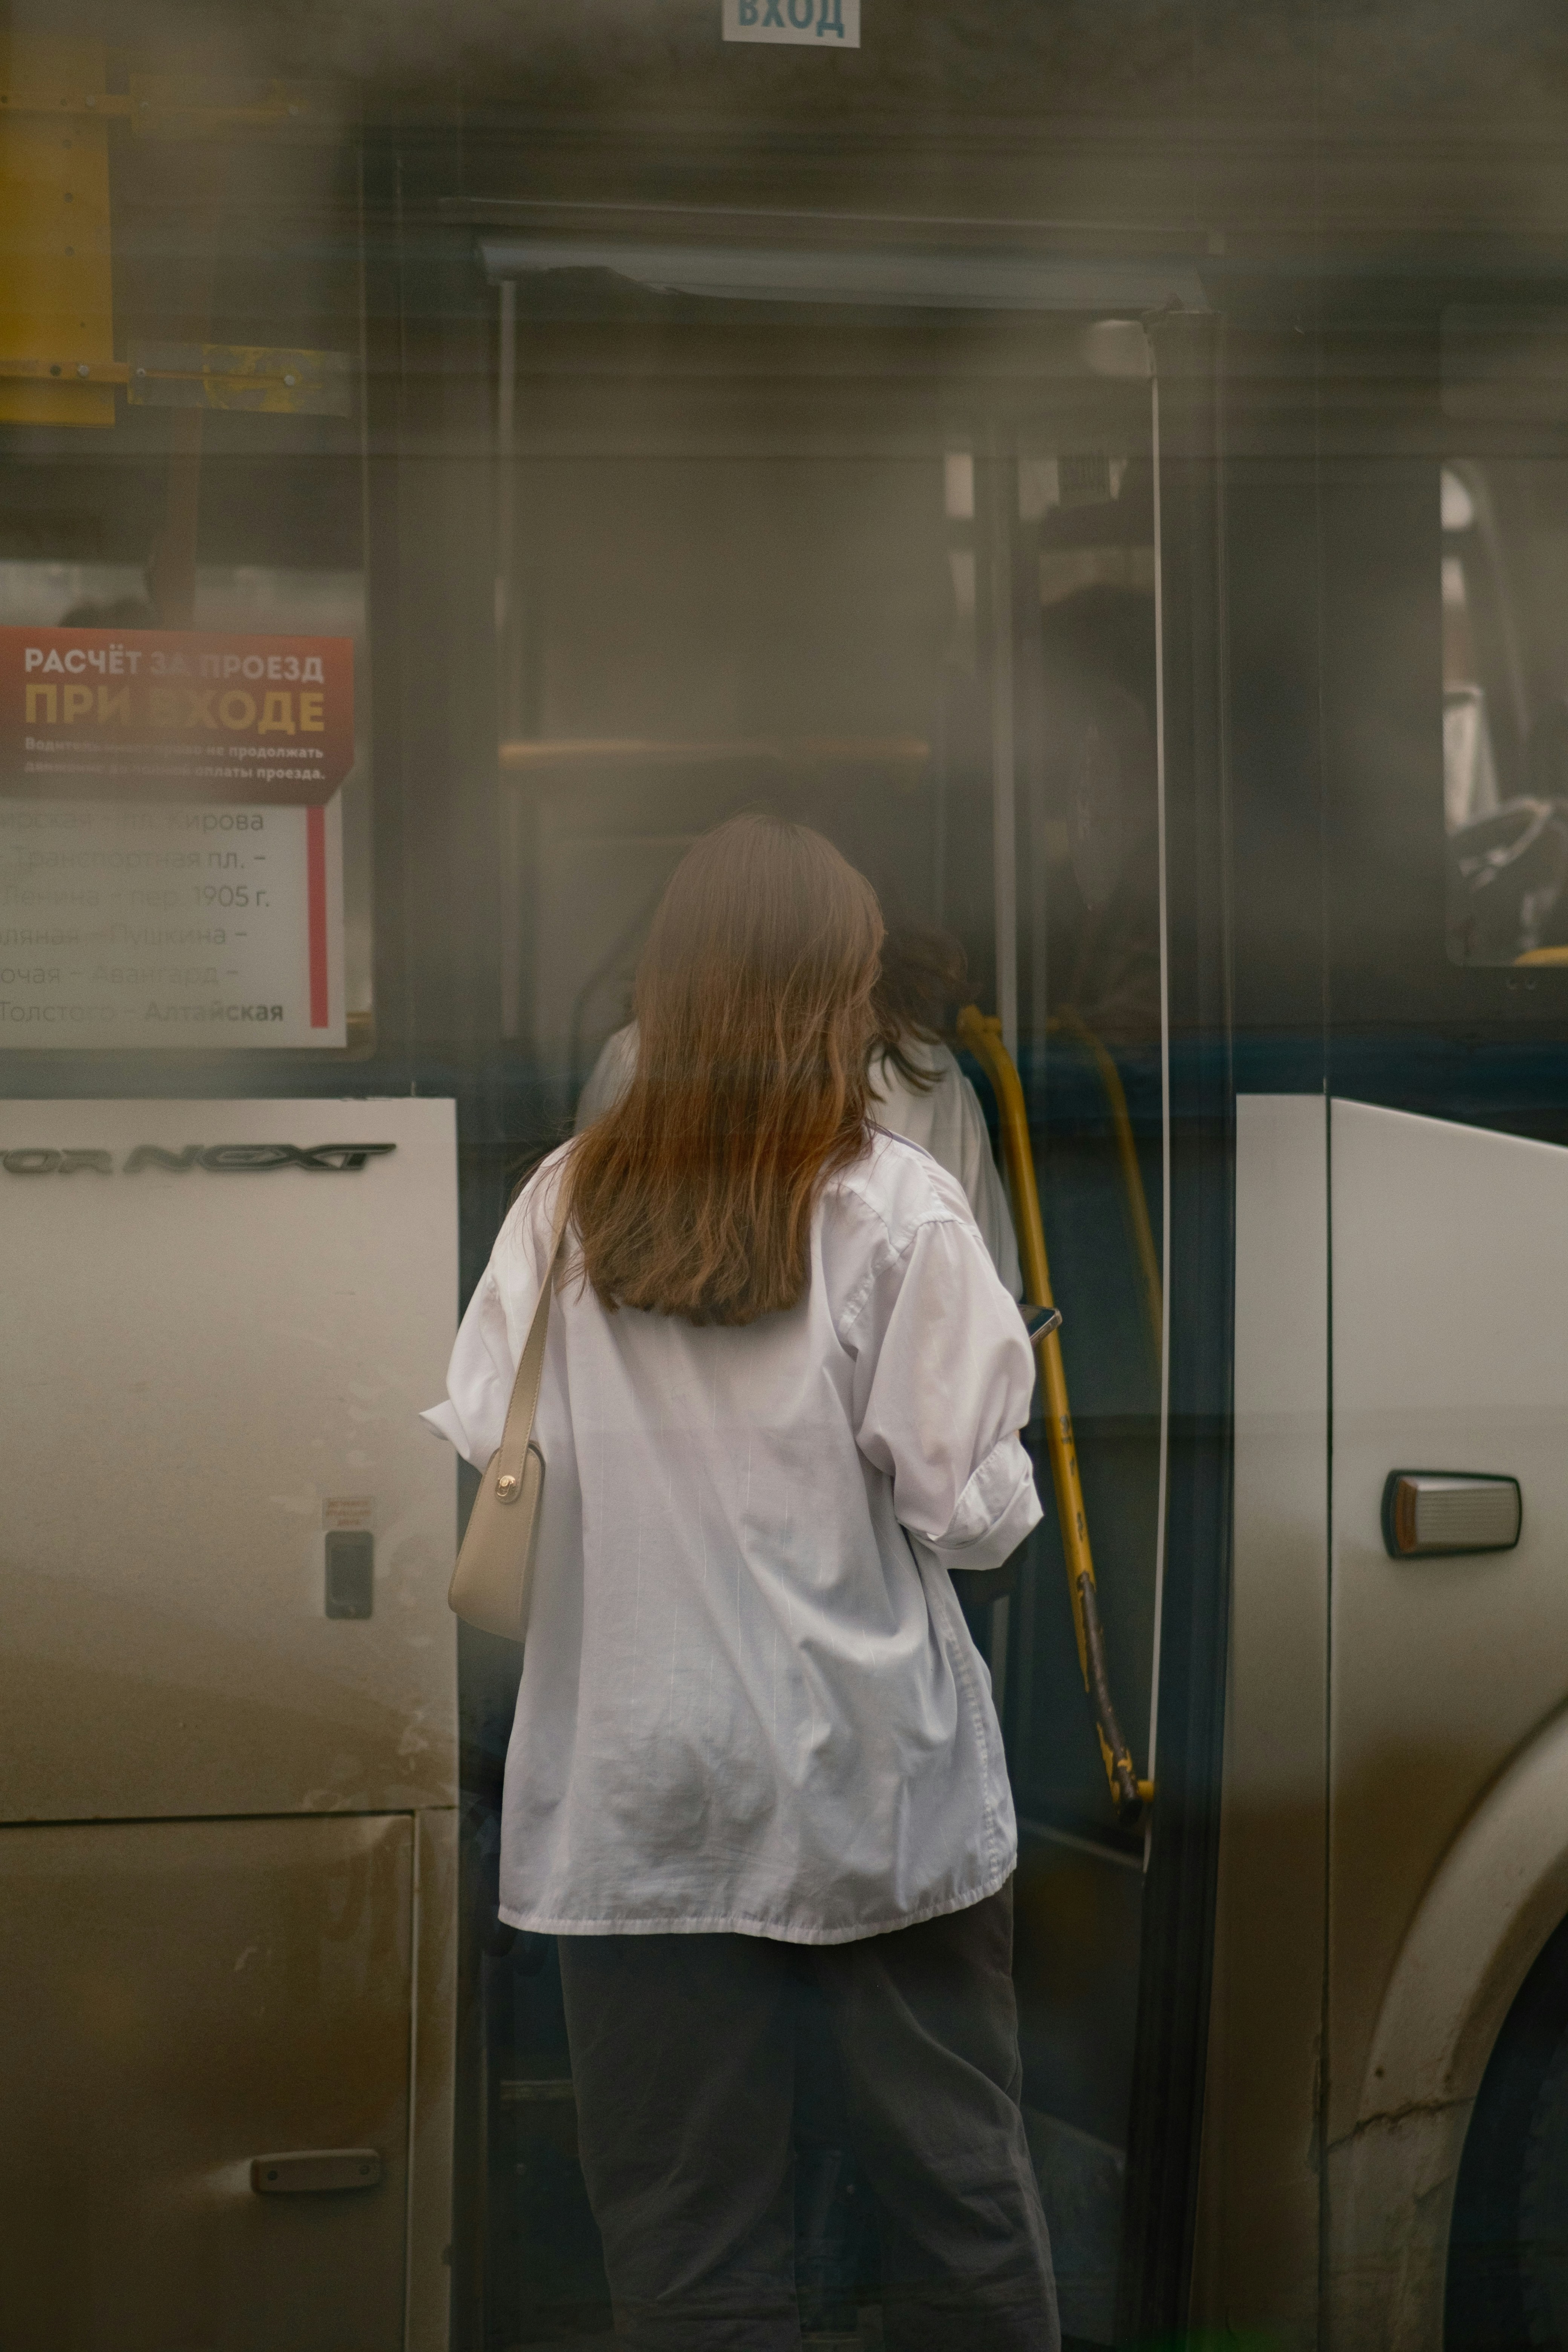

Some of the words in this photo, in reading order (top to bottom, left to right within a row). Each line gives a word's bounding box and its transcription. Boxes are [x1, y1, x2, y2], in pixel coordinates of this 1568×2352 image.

[738, 0, 845, 39] ВХОД
[24, 644, 142, 675] РАСЧЁТ
[150, 652, 190, 677] ЗА
[199, 653, 325, 684] ПРОЕЗД
[25, 683, 130, 726] ПРИ
[148, 687, 325, 735] ВХОДЕ
[207, 745, 224, 756] не
[229, 746, 325, 761] продолжать
[195, 766, 253, 778] оплаты
[257, 767, 326, 782] проезда.
[168, 813, 264, 835] Кирова
[207, 851, 245, 870] пл.
[191, 885, 250, 908] 1905
[255, 890, 271, 908] г.
[0, 927, 80, 946] ляная
[109, 923, 227, 949] Пушкина
[90, 963, 219, 988] Авангард
[0, 1000, 117, 1023] Толстого
[144, 1000, 284, 1023] Алтайская
[0, 1148, 113, 1175] OR
[124, 1143, 397, 1174] NEXT
